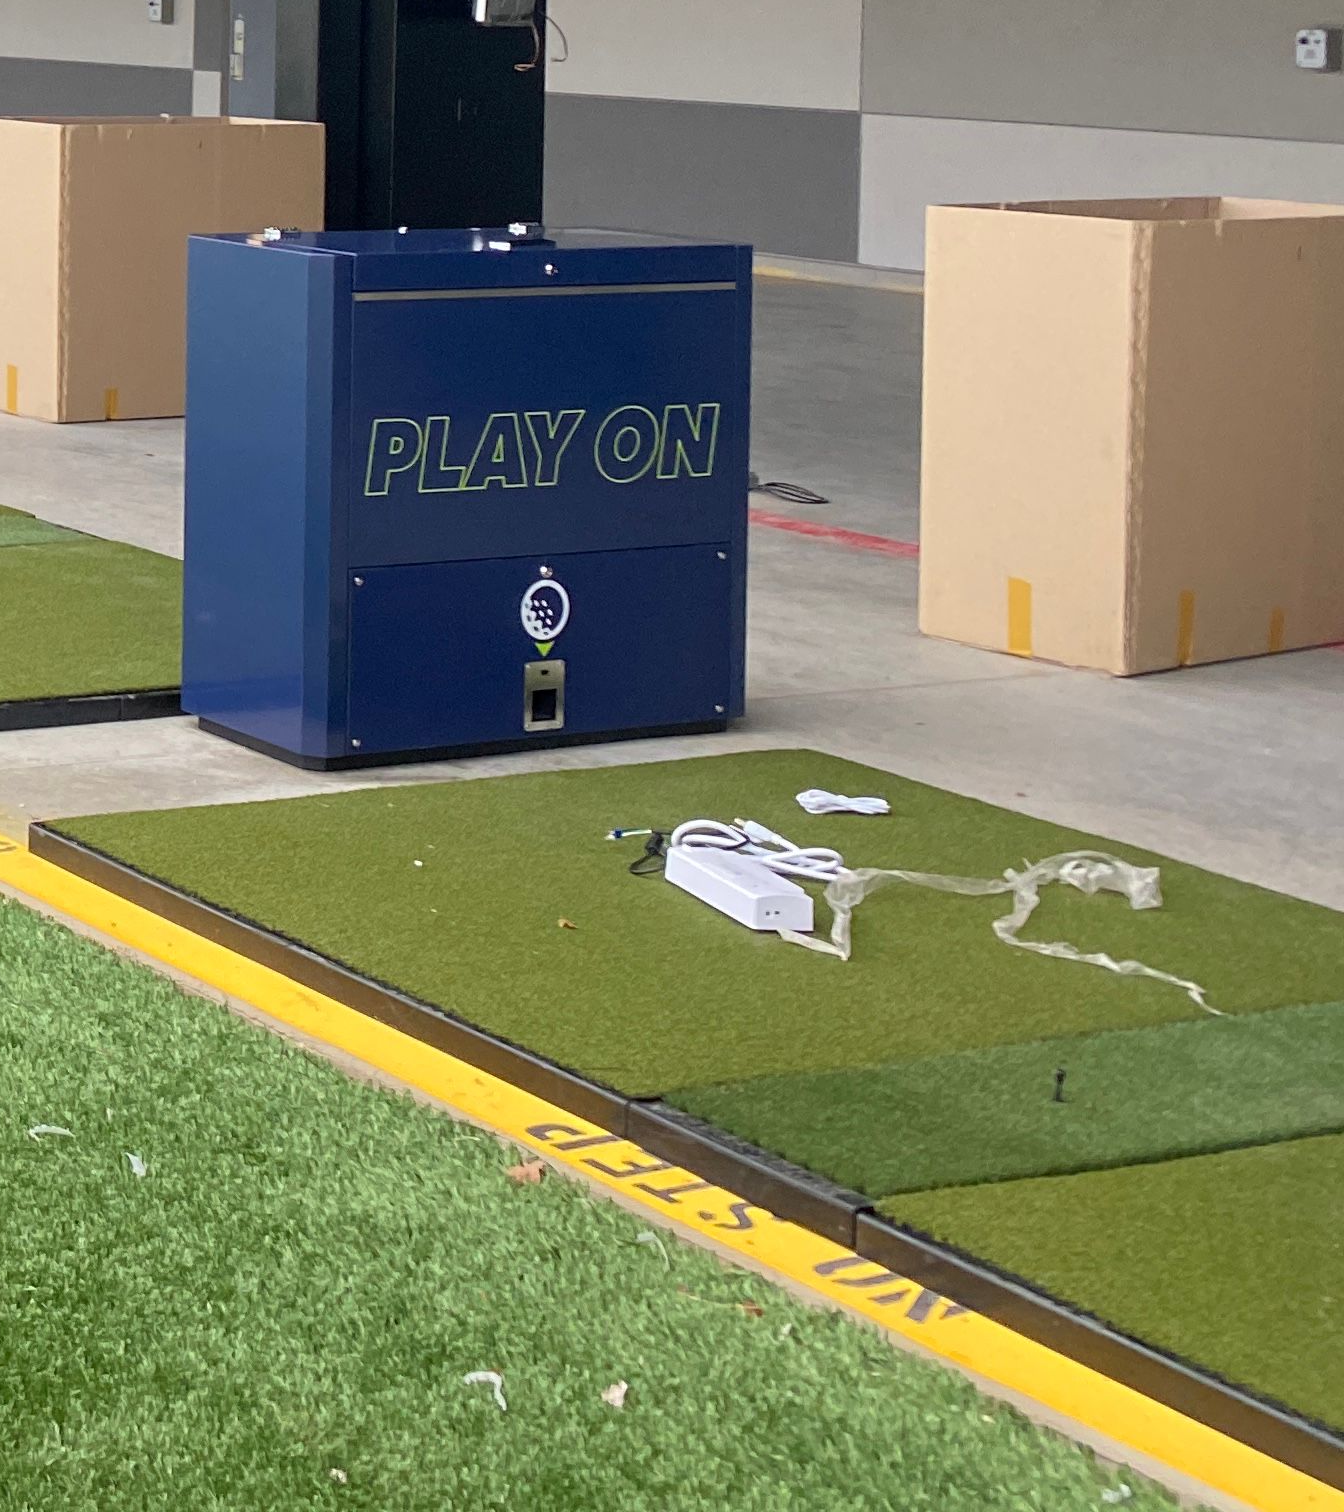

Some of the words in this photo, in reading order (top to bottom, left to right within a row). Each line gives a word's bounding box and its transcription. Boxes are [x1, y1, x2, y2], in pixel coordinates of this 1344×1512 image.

[363, 408, 585, 497] PLAY
[593, 402, 720, 485] ON
[525, 1122, 776, 1232] STEP
